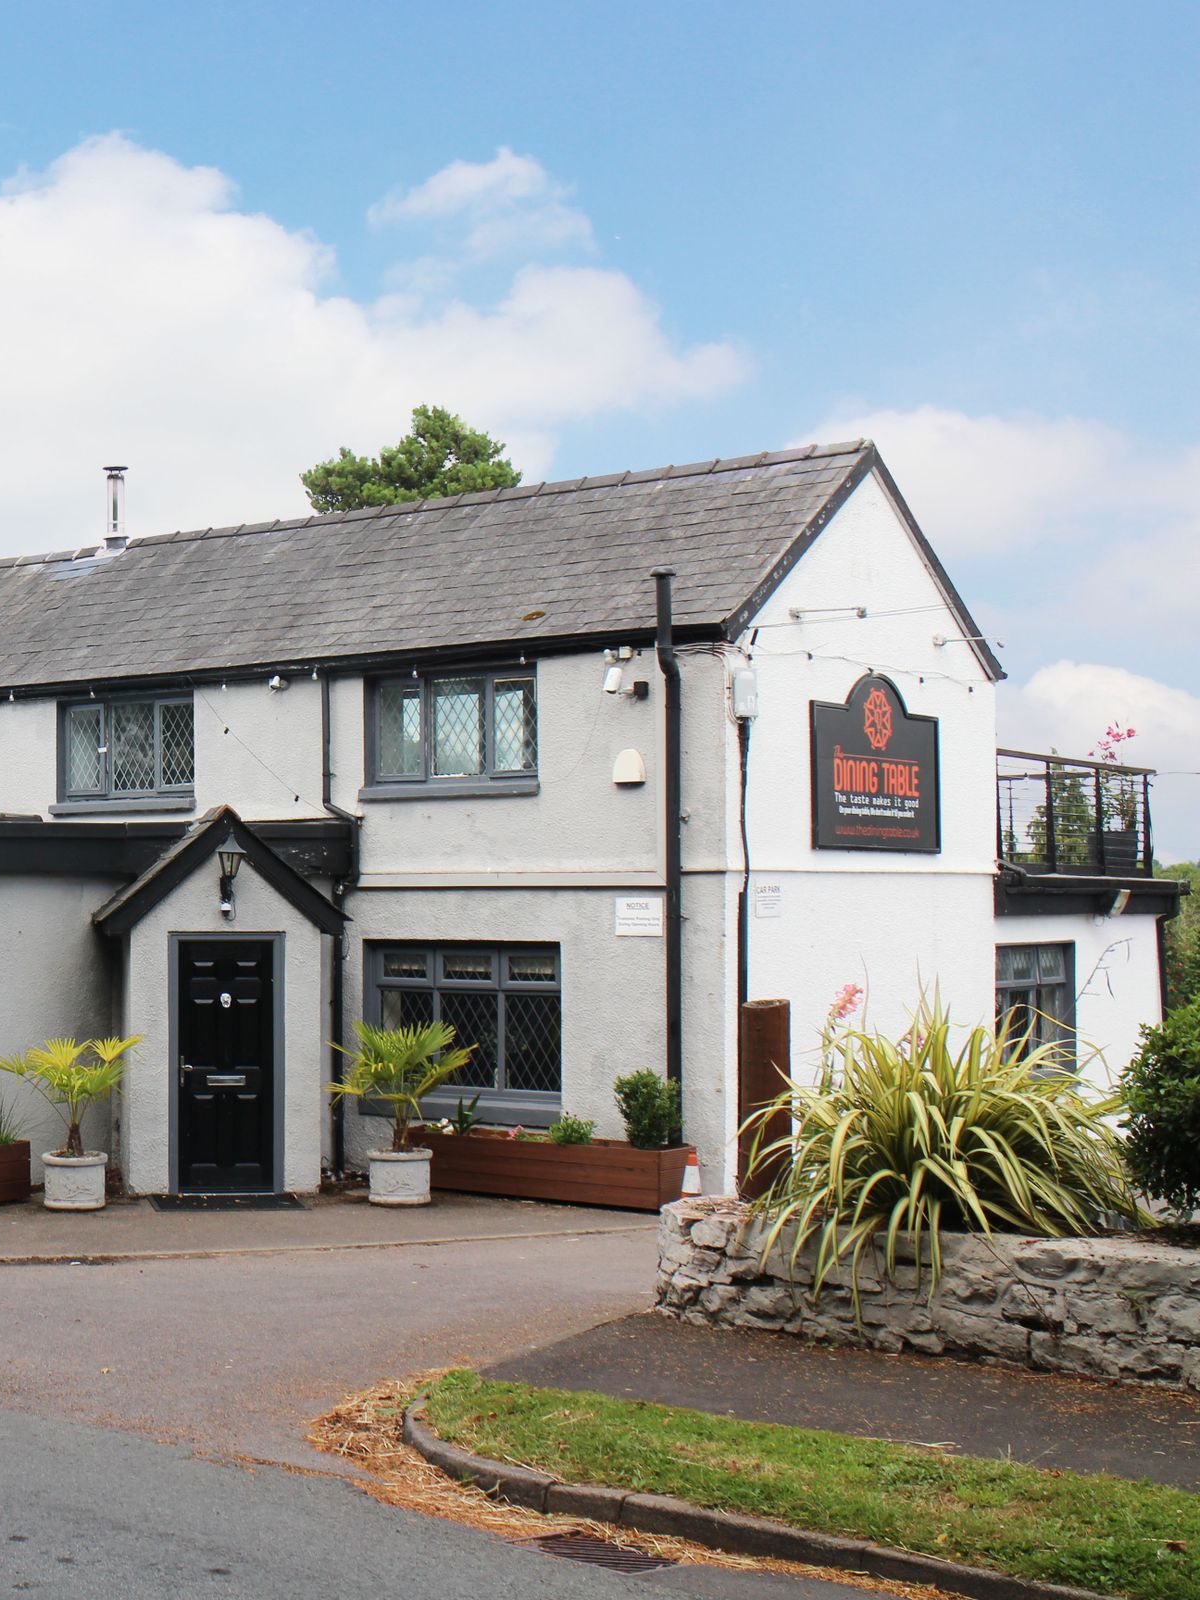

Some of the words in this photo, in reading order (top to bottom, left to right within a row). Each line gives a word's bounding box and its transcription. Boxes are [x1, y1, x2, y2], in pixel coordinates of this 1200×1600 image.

[833, 758, 878, 795] DINING
[882, 763, 920, 797] TABLE
[834, 791, 847, 804] The
[850, 794, 870, 805] taste
[872, 796, 891, 807] makes
[894, 796, 901, 807] it
[904, 798, 919, 810] good
[768, 885, 780, 893] PARK
